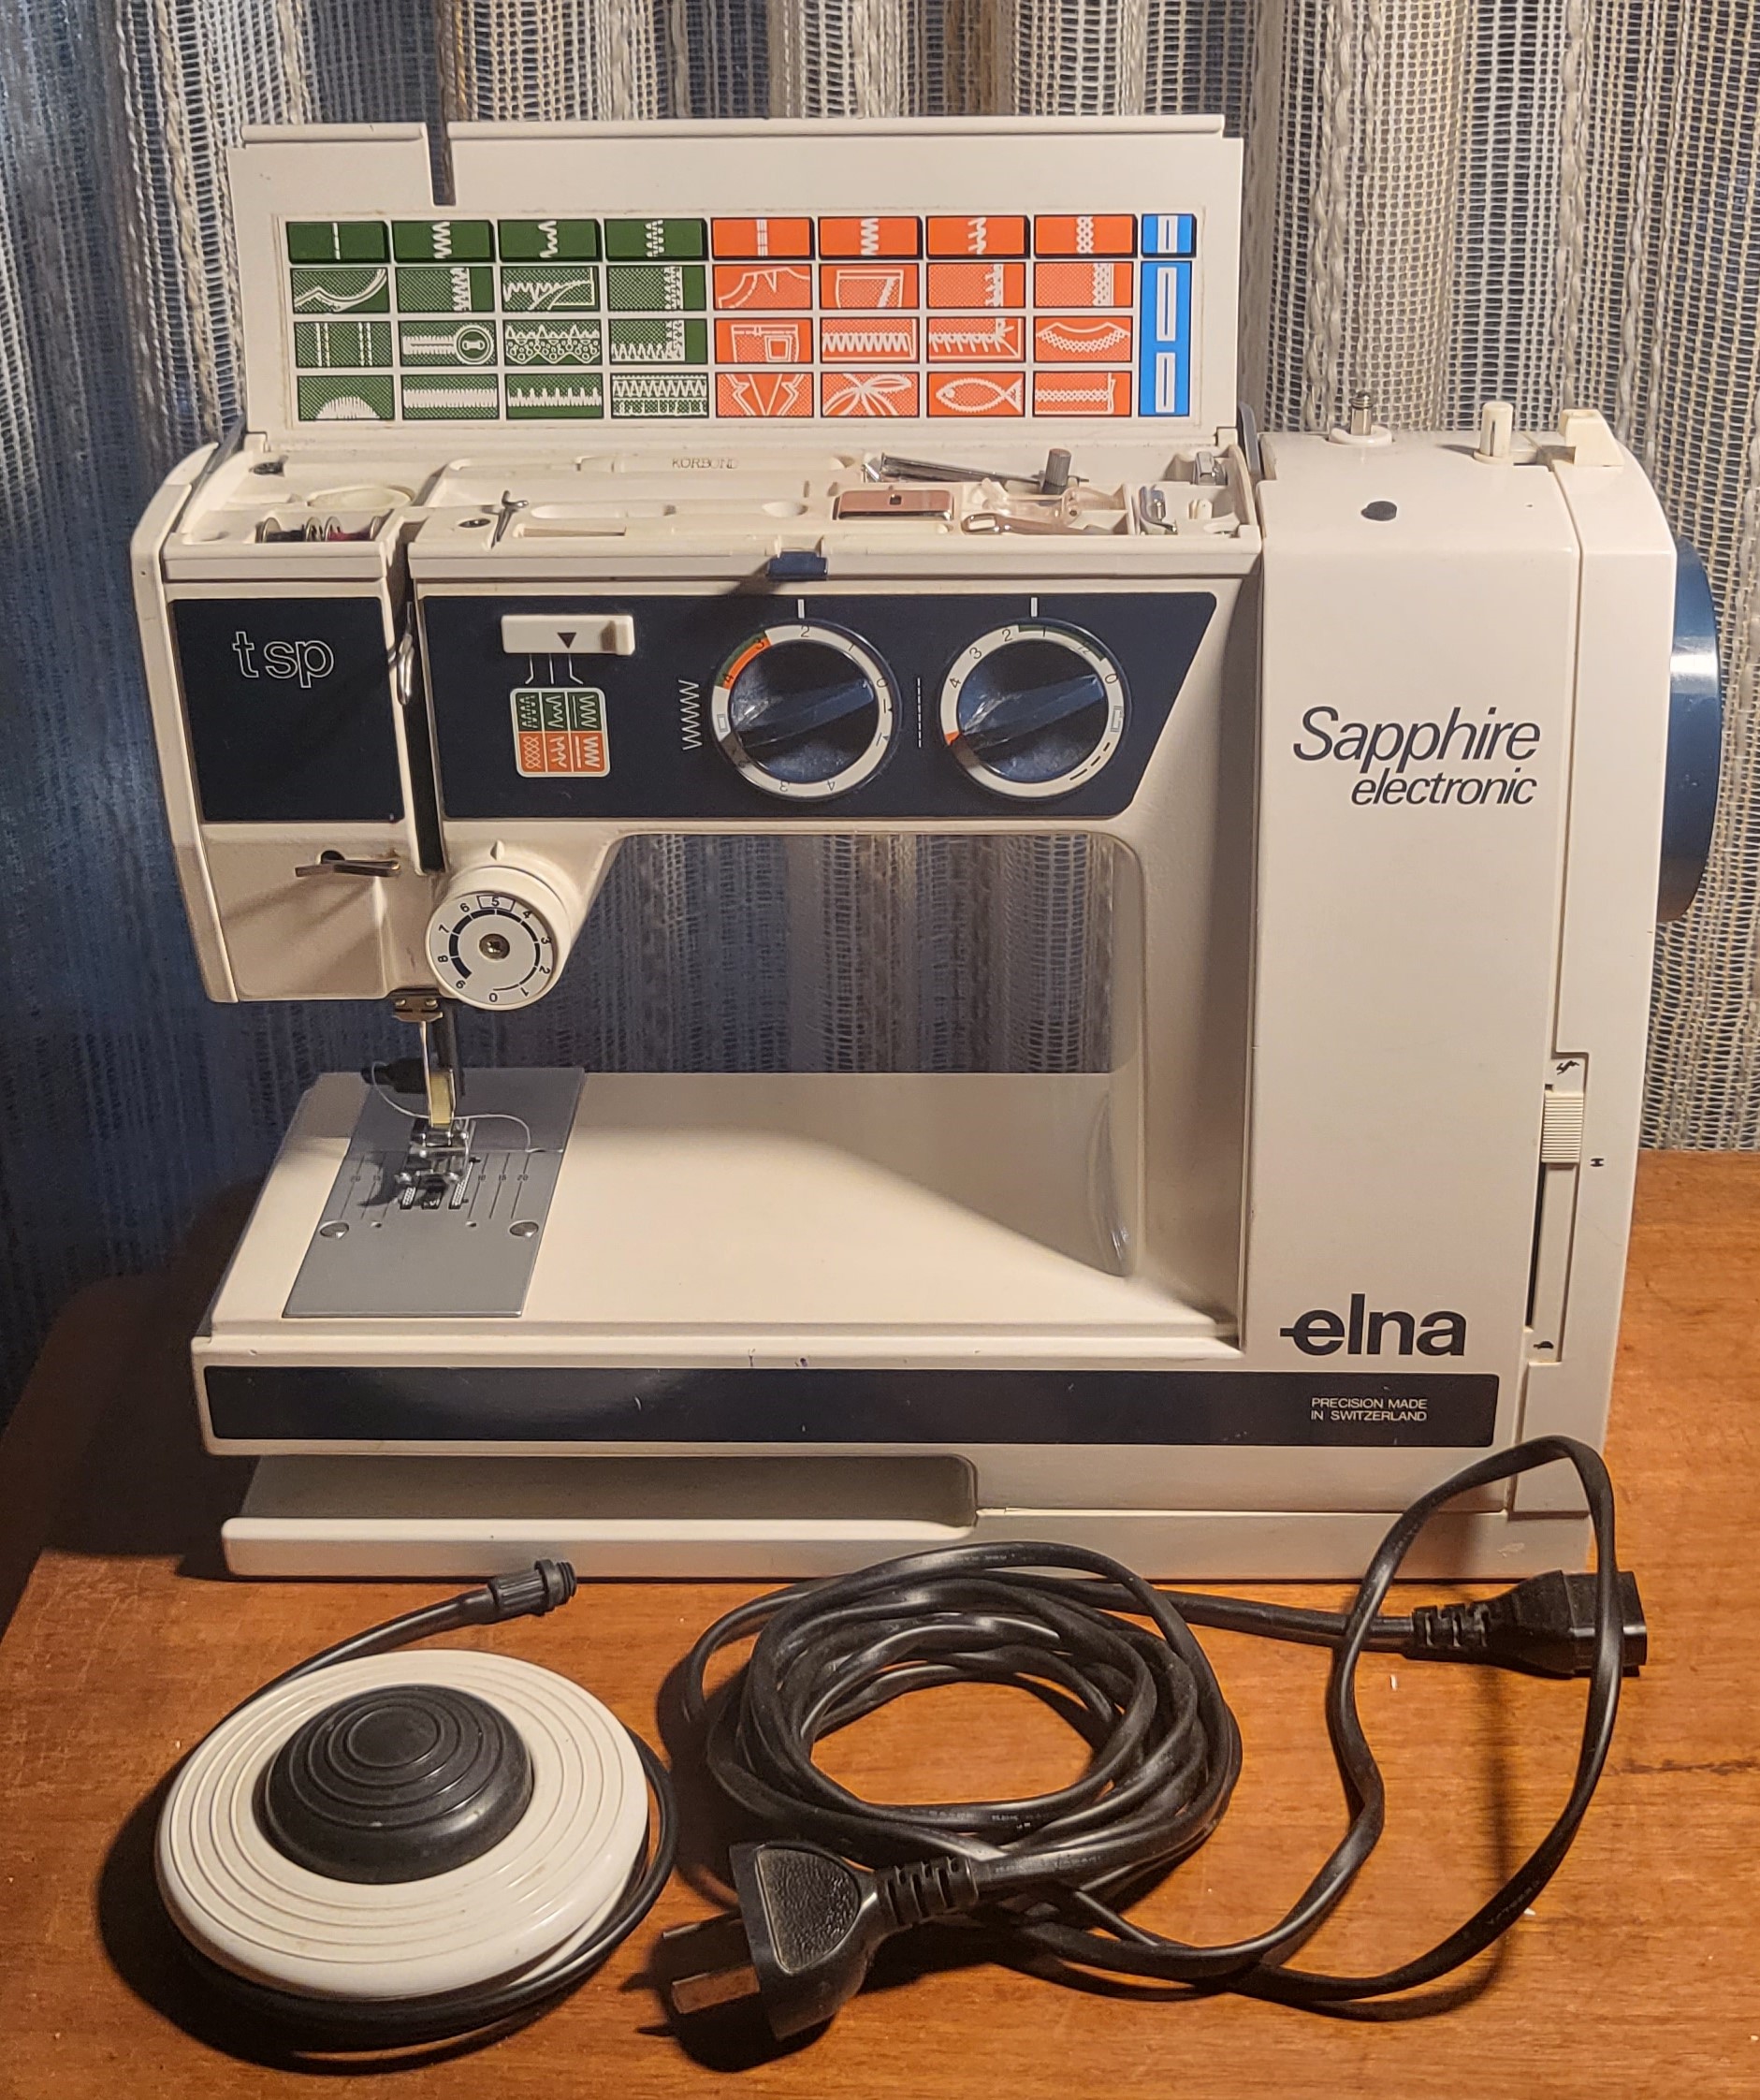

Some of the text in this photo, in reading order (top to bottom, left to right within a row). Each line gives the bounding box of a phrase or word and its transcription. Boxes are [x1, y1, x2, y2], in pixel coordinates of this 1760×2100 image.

[800, 624, 810, 638] 2
[876, 678, 889, 689] 0
[949, 678, 962, 689] 4
[969, 647, 982, 660] 3
[1002, 629, 1013, 642] 2
[1105, 673, 1119, 684] 0
[1292, 706, 1541, 774] Sapphire
[1350, 767, 1537, 806] electronic
[459, 902, 470, 912] 6
[491, 897, 500, 907] 5
[522, 910, 532, 919] 4
[438, 924, 449, 934] 7
[437, 955, 448, 963] 8
[539, 966, 551, 974] 2
[520, 987, 529, 997] 1
[488, 993, 498, 1002] 0
[1280, 1293, 1466, 1356] elna
[1311, 1397, 1428, 1409] PRECISION MADE
[1311, 1410, 1428, 1422] IN SWITZERLAND
